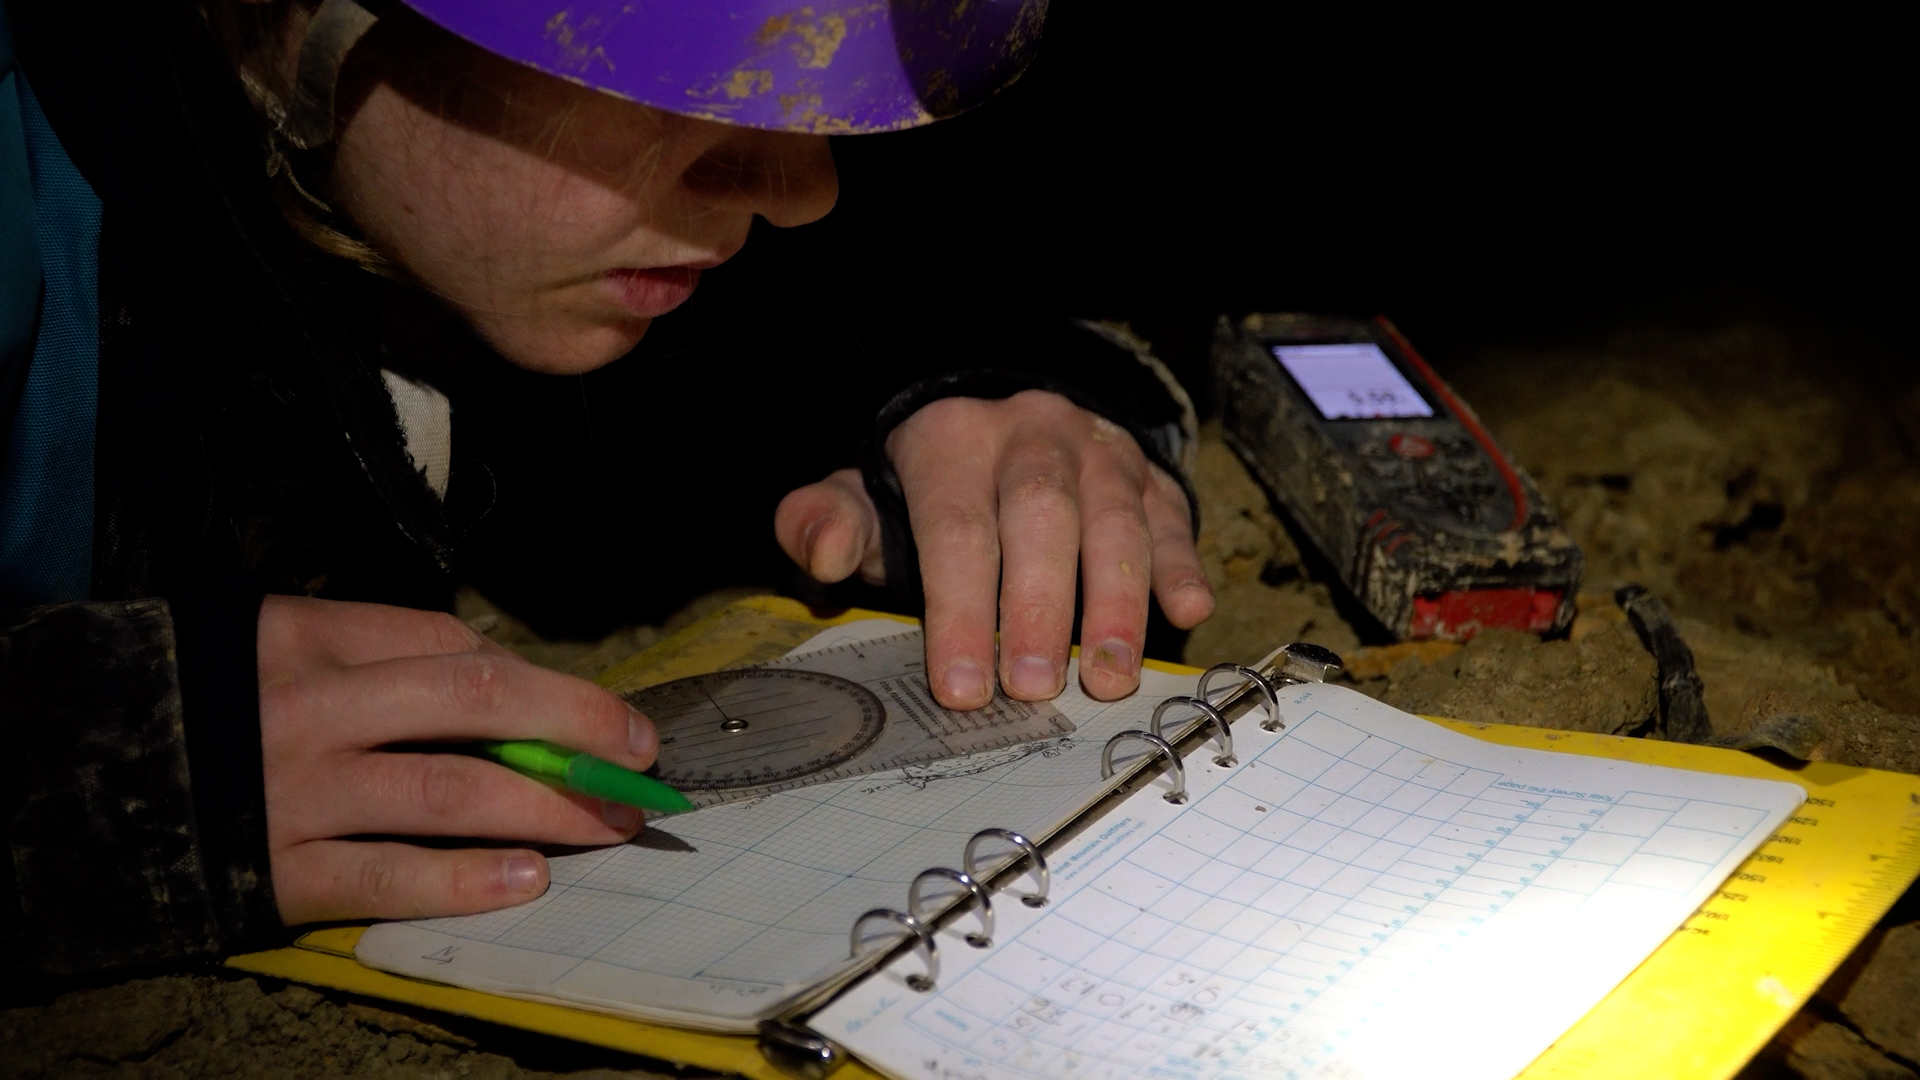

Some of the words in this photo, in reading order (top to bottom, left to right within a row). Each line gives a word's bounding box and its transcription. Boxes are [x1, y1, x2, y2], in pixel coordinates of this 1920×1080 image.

[1498, 781, 1527, 789] page
[1550, 788, 1587, 798] Survey
[1589, 793, 1614, 801] Total
[1069, 839, 1102, 861] Mountain
[1099, 817, 1132, 840] Outfitters
